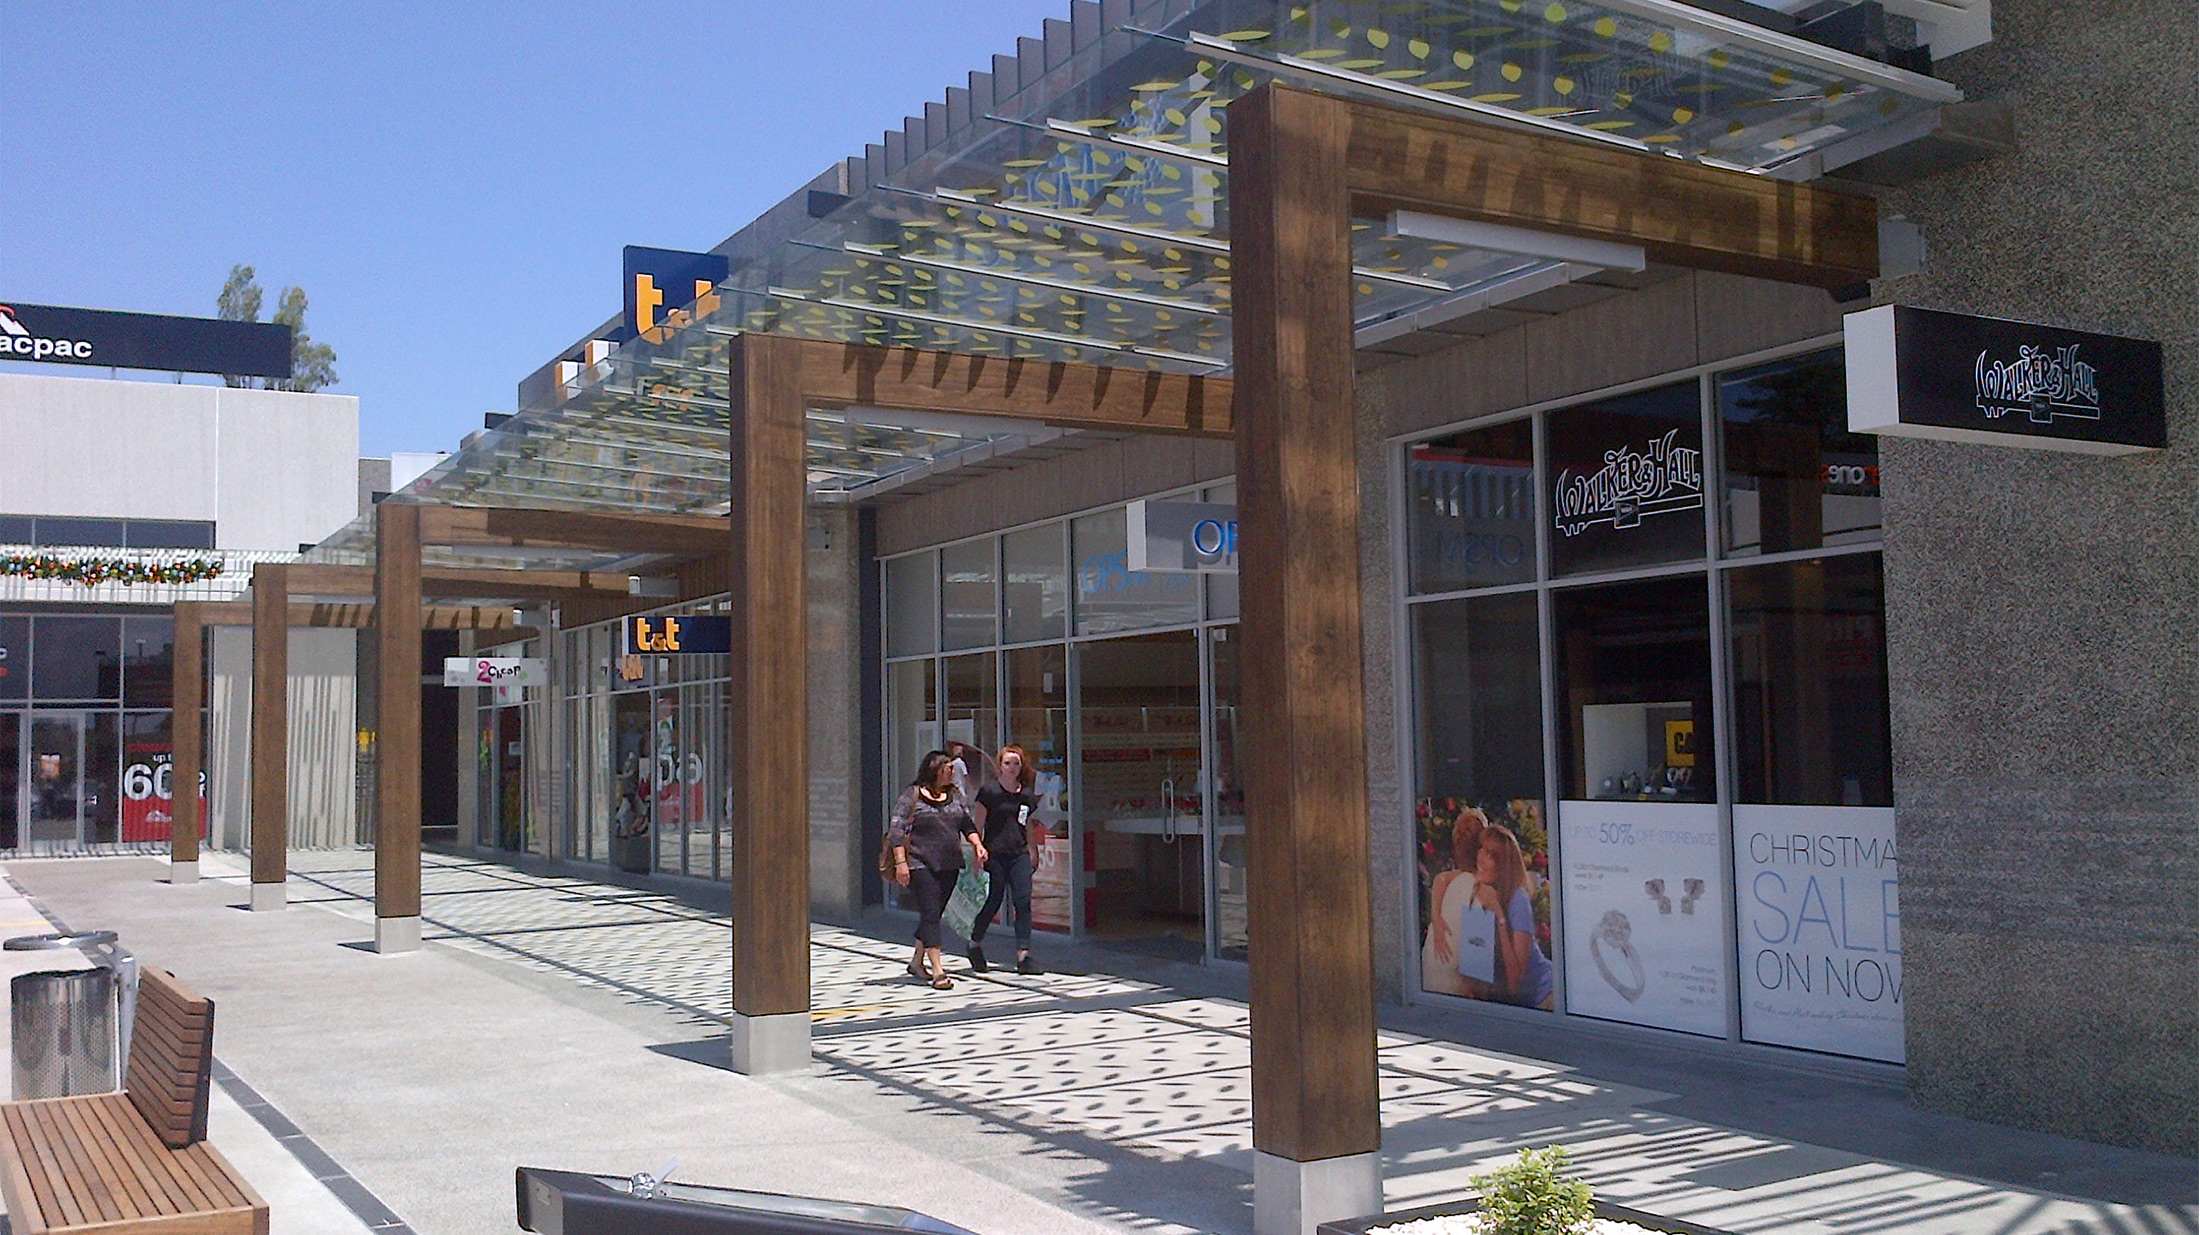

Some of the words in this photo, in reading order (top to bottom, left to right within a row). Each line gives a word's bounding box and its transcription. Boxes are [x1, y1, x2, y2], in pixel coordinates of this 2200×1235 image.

[636, 617, 681, 651] t&t
[1600, 822, 1635, 845] 50%
[1636, 828, 1655, 842] OFF
[1750, 832, 1898, 869] CHRISTMA
[1755, 949, 1811, 993] ON
